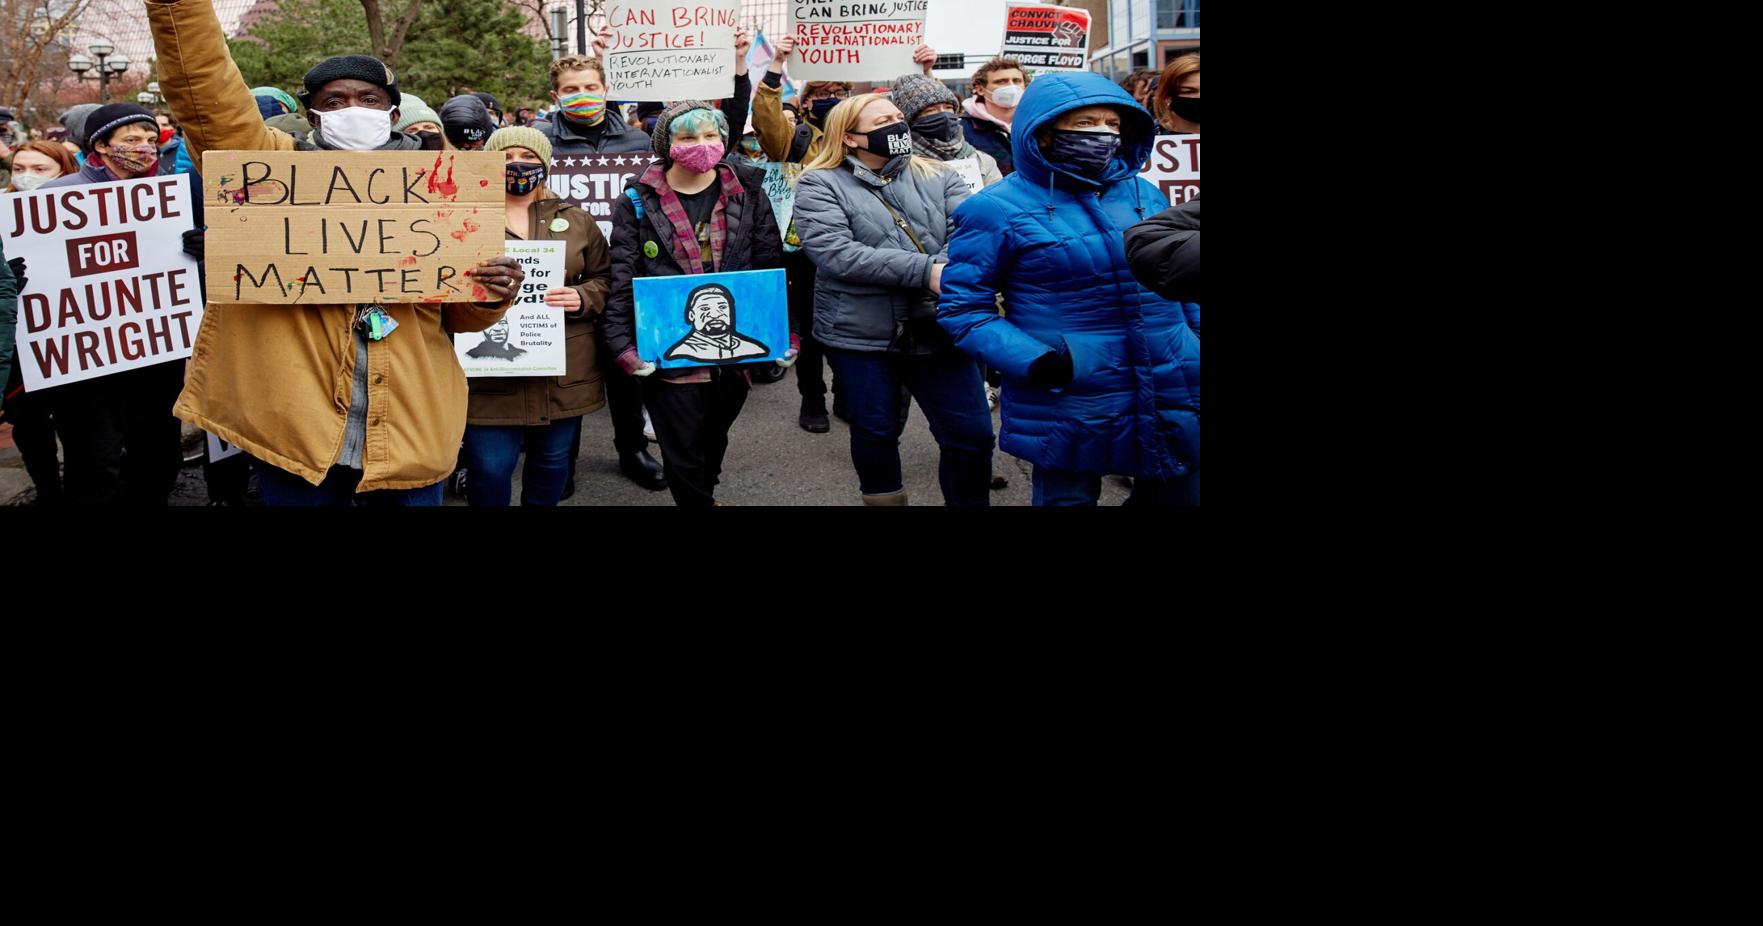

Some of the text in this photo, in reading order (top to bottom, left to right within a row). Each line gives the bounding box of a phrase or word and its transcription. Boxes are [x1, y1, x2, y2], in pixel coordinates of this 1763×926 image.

[609, 5, 736, 28] CAN BRING
[795, 0, 928, 19] CAN BRING JUSTICE
[796, 22, 922, 36] REVOLUTIONARY
[612, 31, 704, 50] JUSTICE!
[796, 35, 922, 46] INTERNATIONALIST
[1005, 36, 1071, 46] JUSTICE FOR
[609, 54, 716, 69] REVOLUTIONARY
[798, 48, 860, 64] YOUTH
[1048, 55, 1082, 66] FLOYD
[610, 66, 724, 79] INTERNATIONALIST
[610, 80, 653, 91] YOUTH
[887, 133, 910, 141] BLA
[241, 161, 430, 206] BLACK
[547, 173, 636, 200] USTI
[10, 180, 181, 238] JUSTICE
[581, 202, 611, 216] FOR
[284, 217, 441, 257] LIVES
[78, 238, 129, 269] FOR
[530, 268, 551, 277] for
[235, 263, 462, 303] MATTER
[22, 268, 190, 334] DAUNTE
[30, 311, 193, 379] WRIGHT
